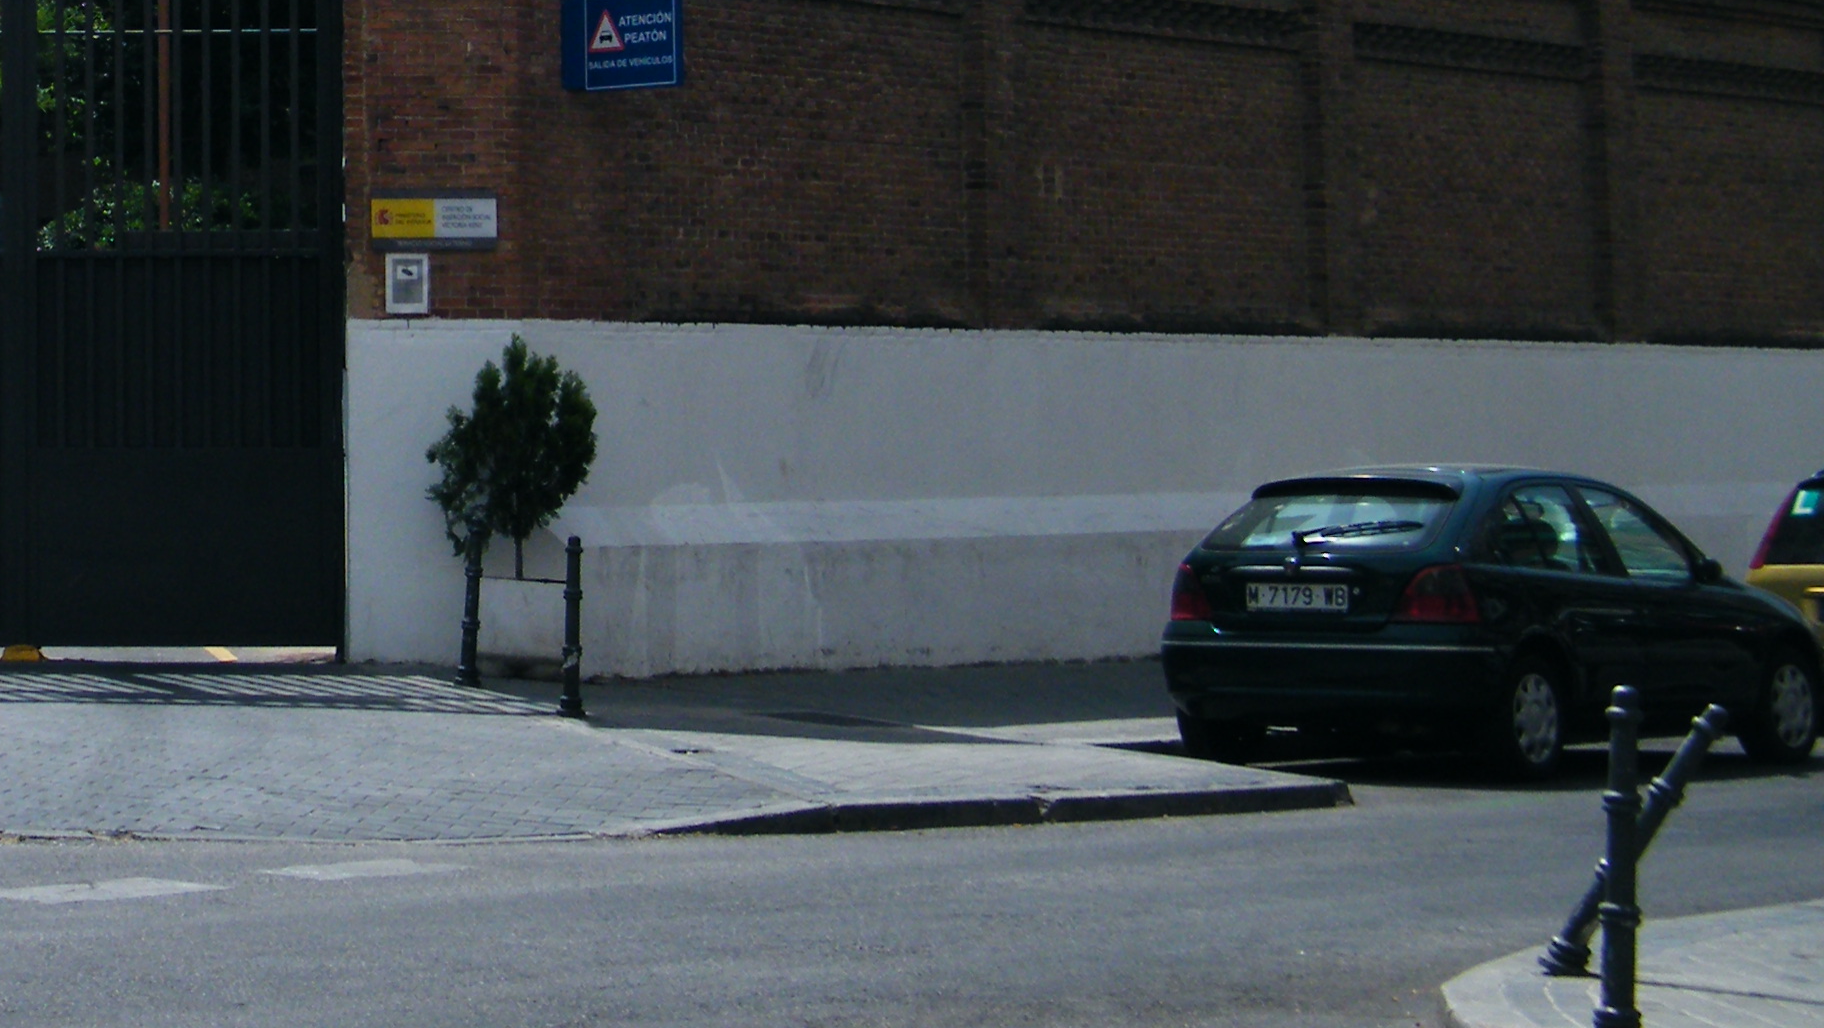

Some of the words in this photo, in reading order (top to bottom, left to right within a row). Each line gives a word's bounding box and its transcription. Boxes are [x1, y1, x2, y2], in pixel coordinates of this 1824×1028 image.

[618, 10, 673, 27] ATENCIÓN
[624, 29, 667, 44] PEATÓN
[588, 58, 616, 71] SALIDA
[617, 57, 628, 68] DE
